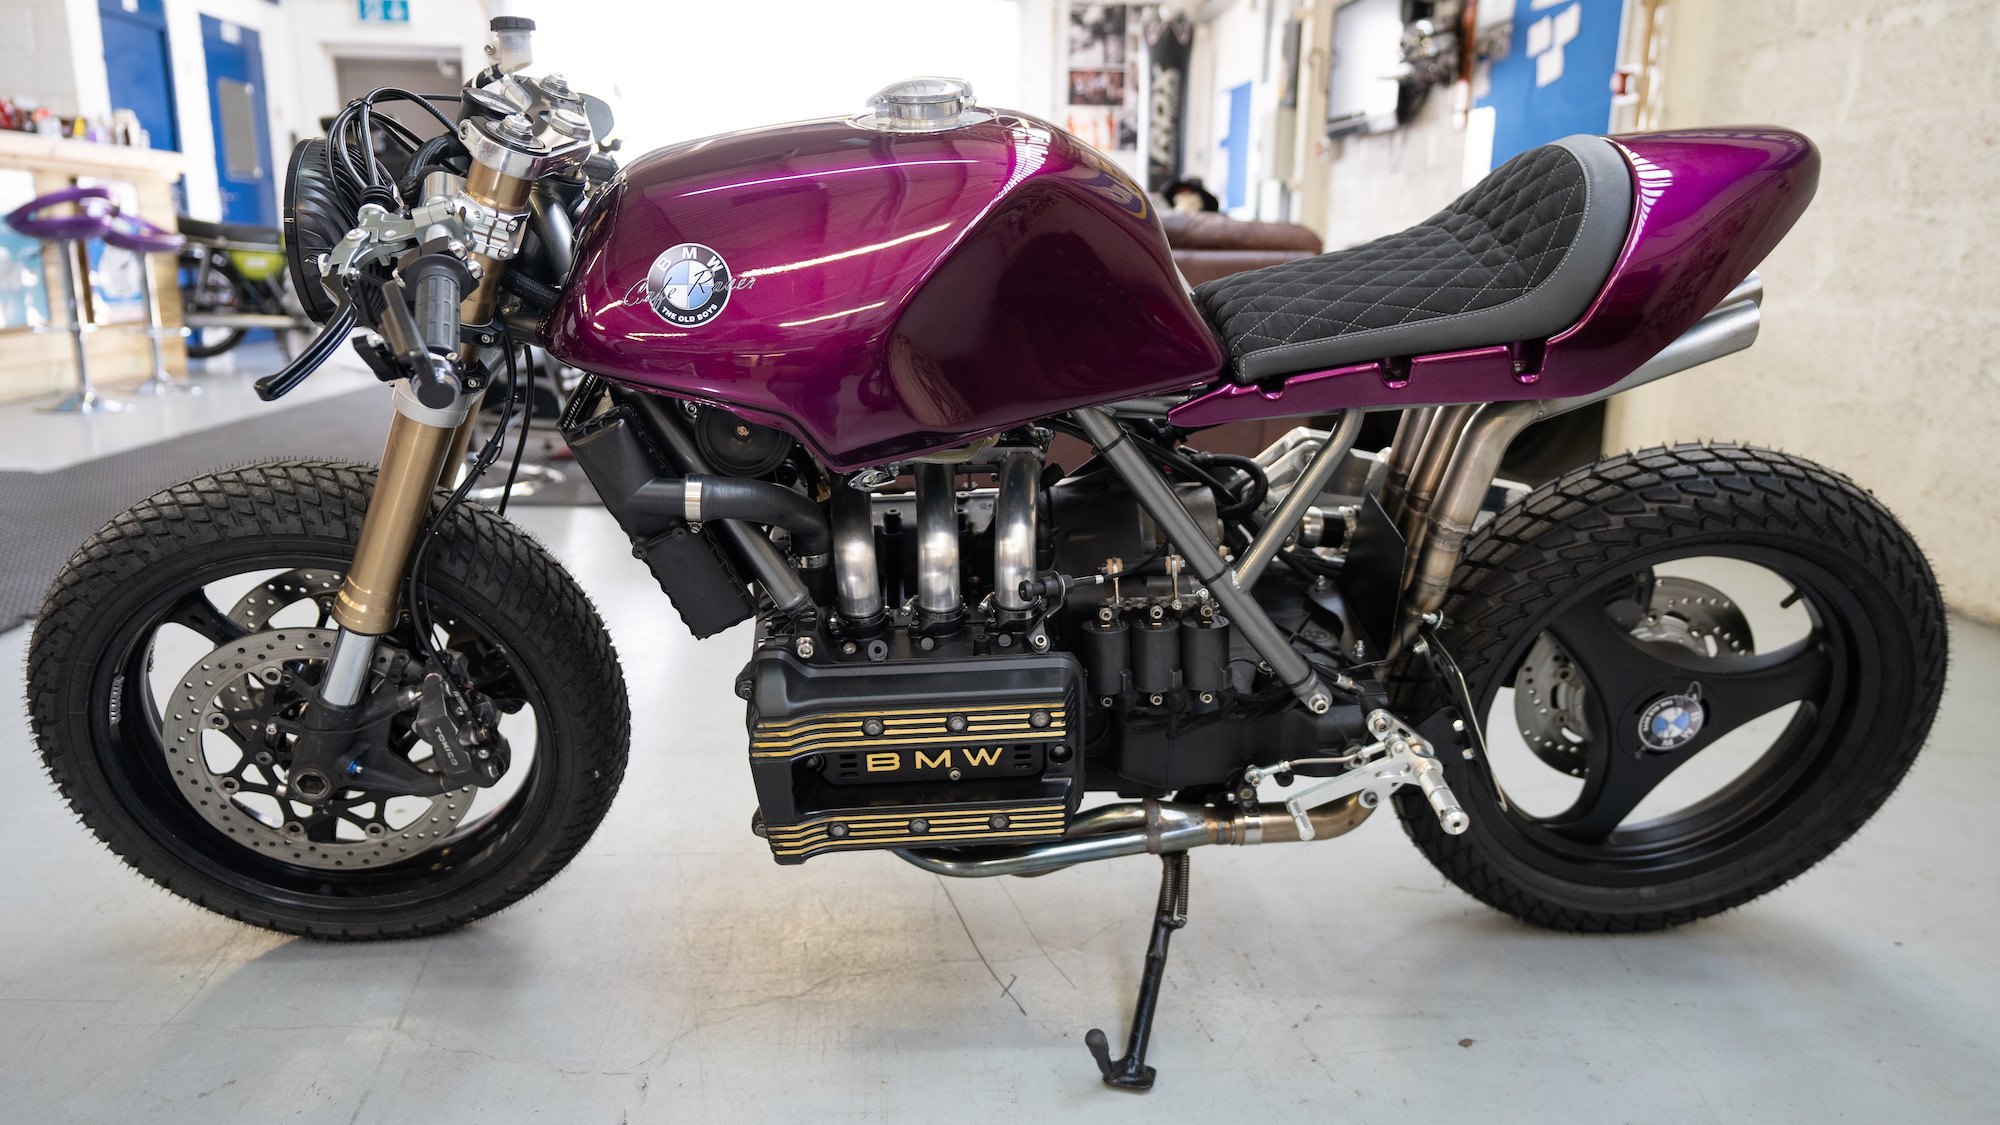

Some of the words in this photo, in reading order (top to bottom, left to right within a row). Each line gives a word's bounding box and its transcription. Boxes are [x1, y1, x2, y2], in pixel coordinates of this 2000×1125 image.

[656, 246, 724, 273] BMW
[688, 269, 756, 297] Racer
[661, 306, 677, 320] THE
[678, 315, 696, 323] OLD
[697, 303, 718, 321] BOYS
[434, 726, 459, 766] TOKICO
[866, 747, 1003, 772] BMW
